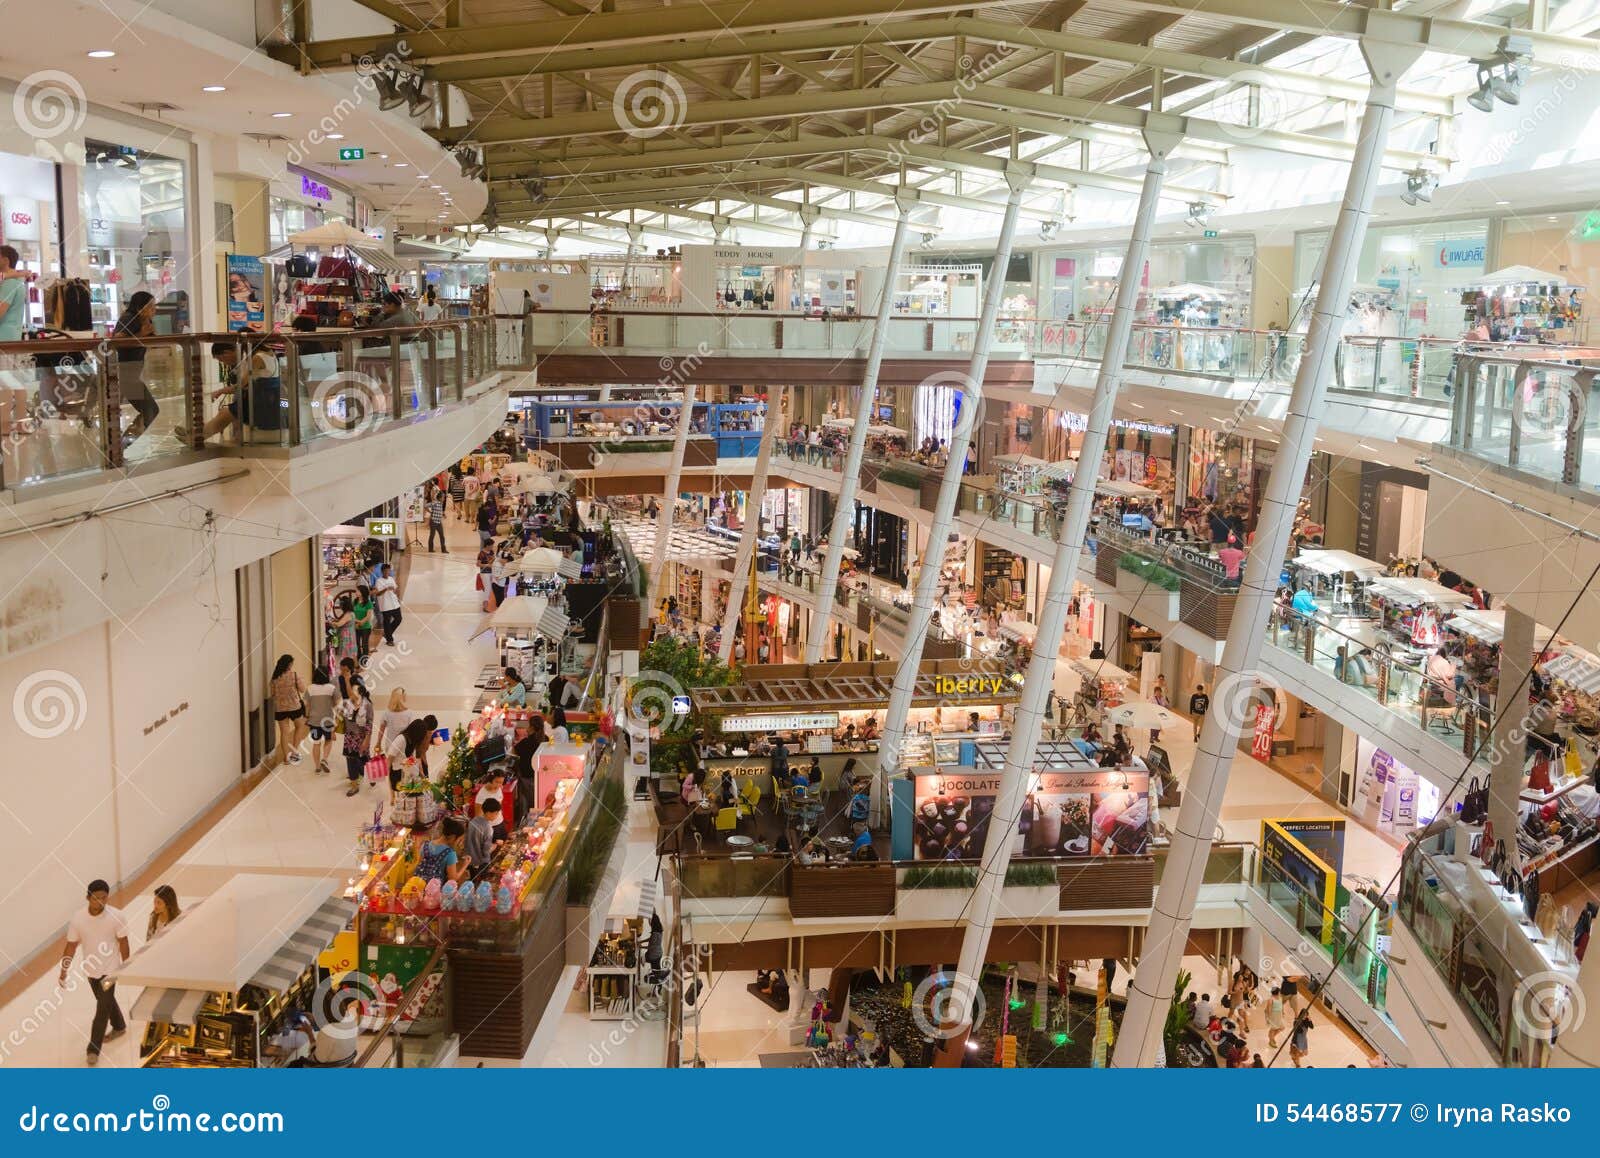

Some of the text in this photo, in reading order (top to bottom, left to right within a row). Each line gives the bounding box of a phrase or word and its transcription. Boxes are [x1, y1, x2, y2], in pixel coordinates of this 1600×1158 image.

[714, 250, 774, 259] TEDDY HOUSE
[935, 674, 1003, 696] iberry
[1255, 731, 1270, 751] 70
